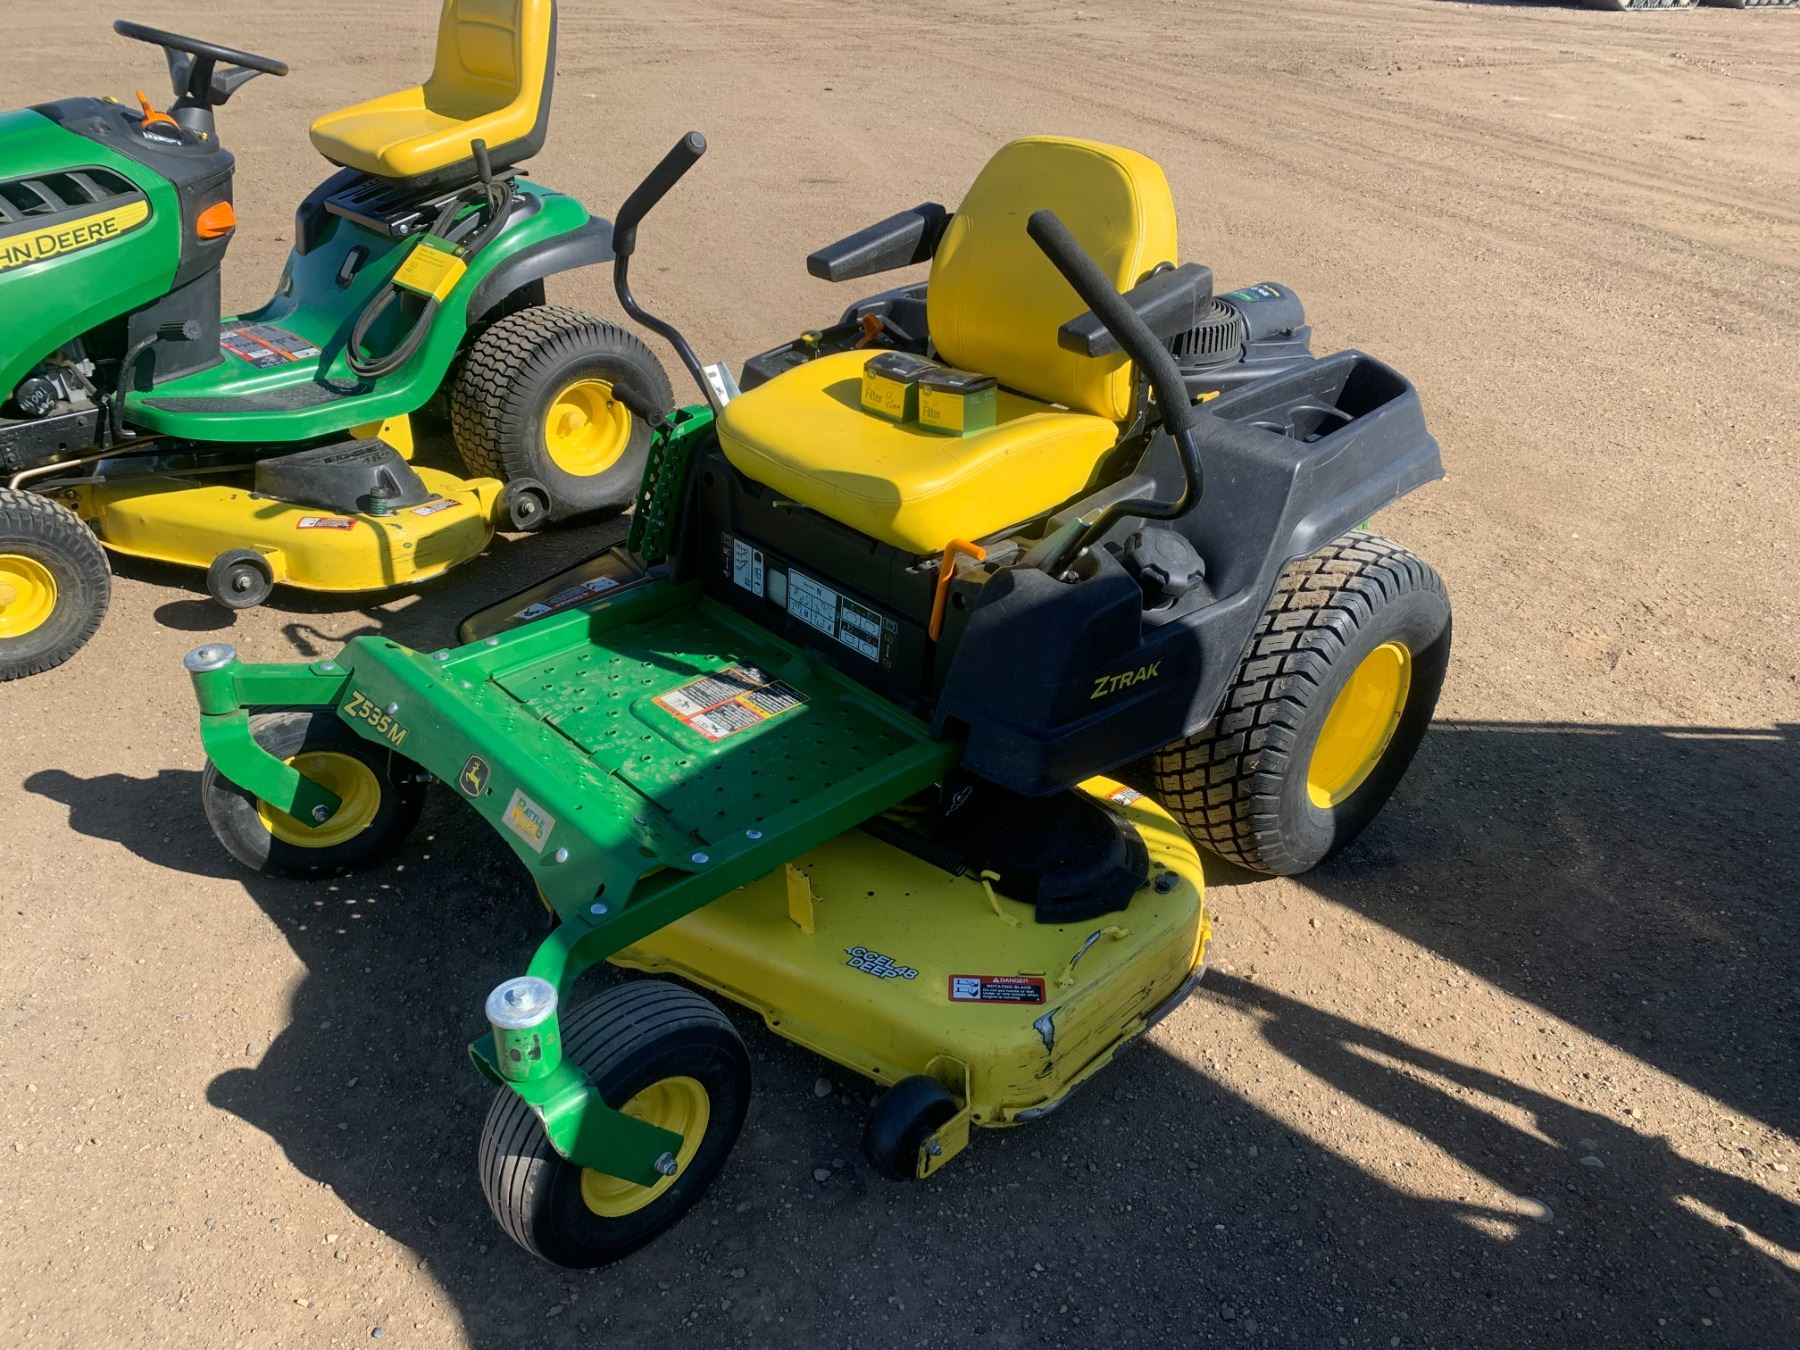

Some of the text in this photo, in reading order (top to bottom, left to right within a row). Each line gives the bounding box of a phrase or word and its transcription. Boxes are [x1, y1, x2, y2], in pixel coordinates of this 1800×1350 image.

[35, 216, 119, 255] DEERE
[1090, 660, 1162, 699] ZTRAK
[343, 689, 408, 747] Z535M
[847, 956, 897, 978] DEEP
[894, 966, 920, 980] 48
